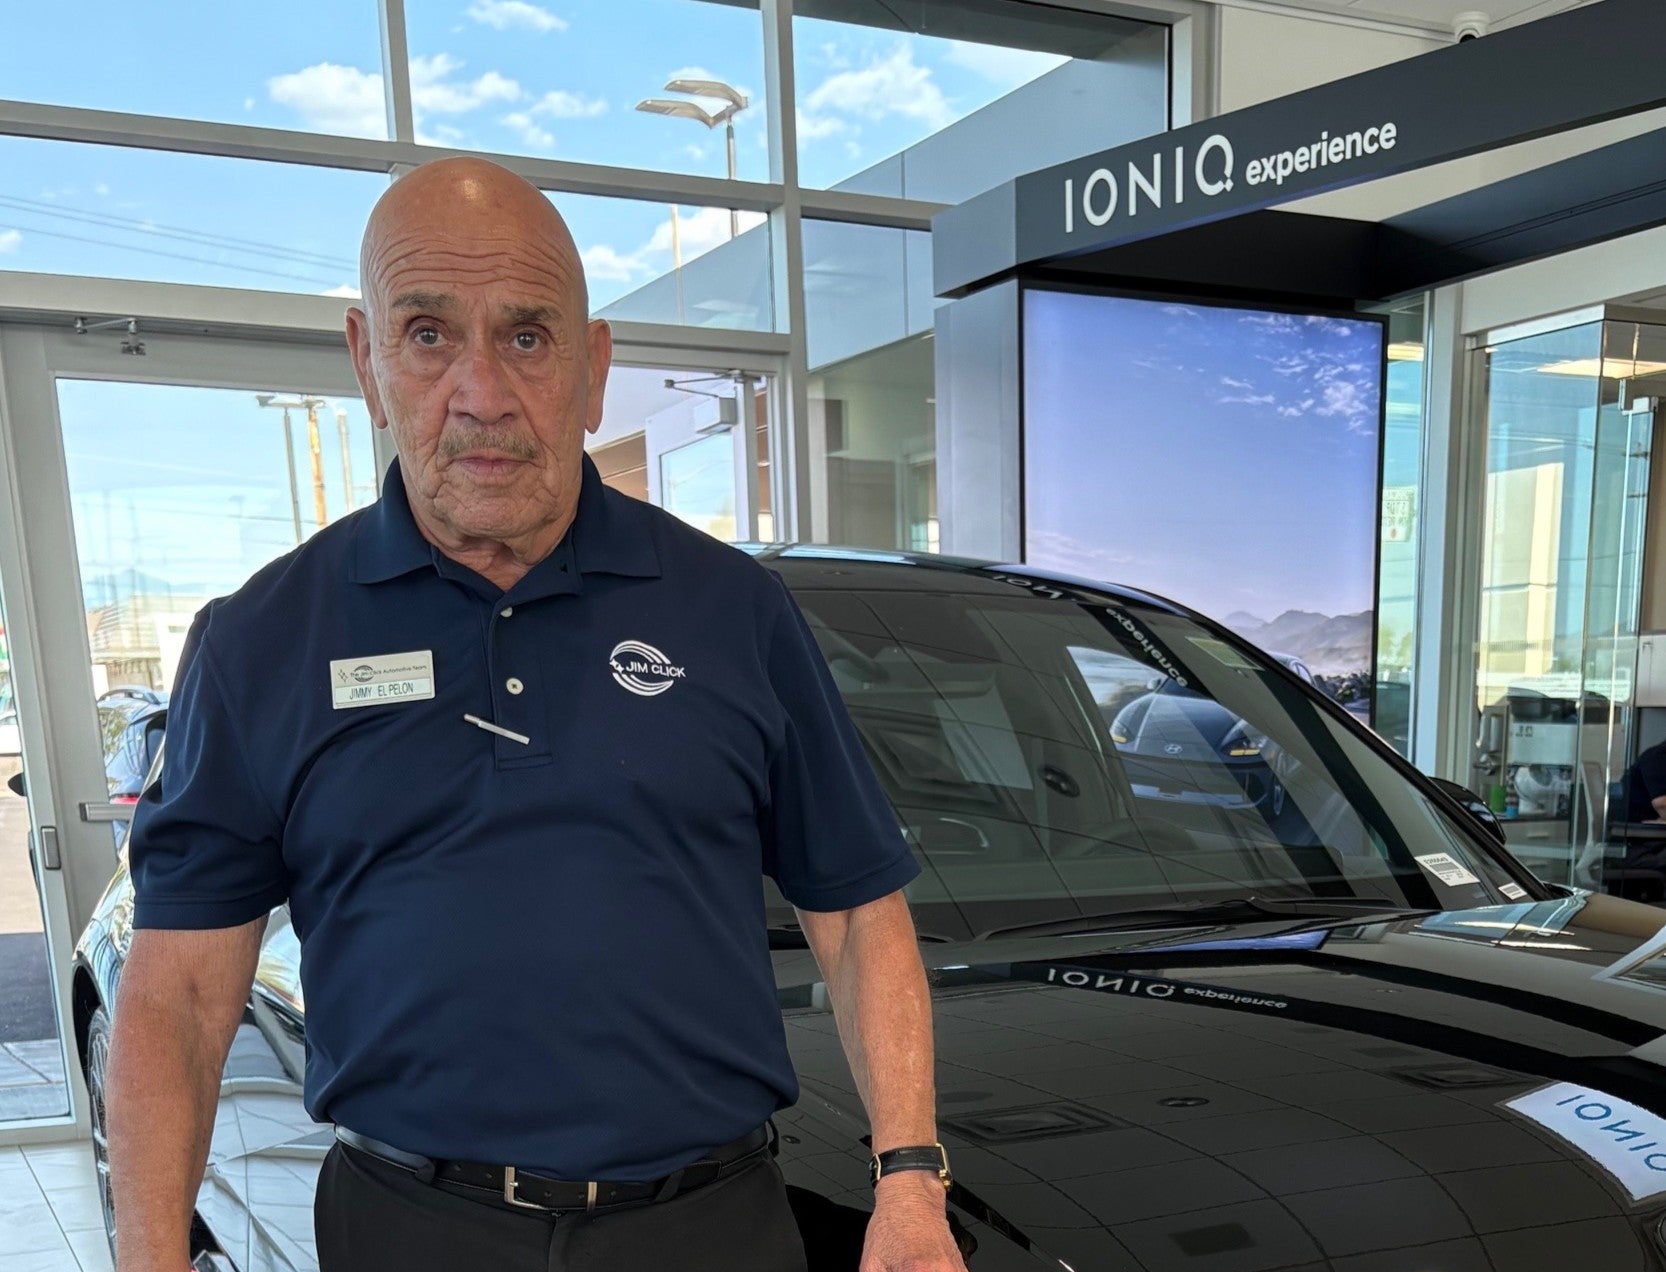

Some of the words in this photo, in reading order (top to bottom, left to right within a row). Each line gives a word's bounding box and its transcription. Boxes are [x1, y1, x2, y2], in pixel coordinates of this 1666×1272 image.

[1065, 134, 1235, 233] IONIQ
[1246, 122, 1397, 185] experience
[626, 661, 649, 674] JIM
[651, 664, 686, 678] CLICK
[350, 686, 372, 699] JIMMY
[378, 685, 388, 697] EL
[389, 682, 414, 696] PELON
